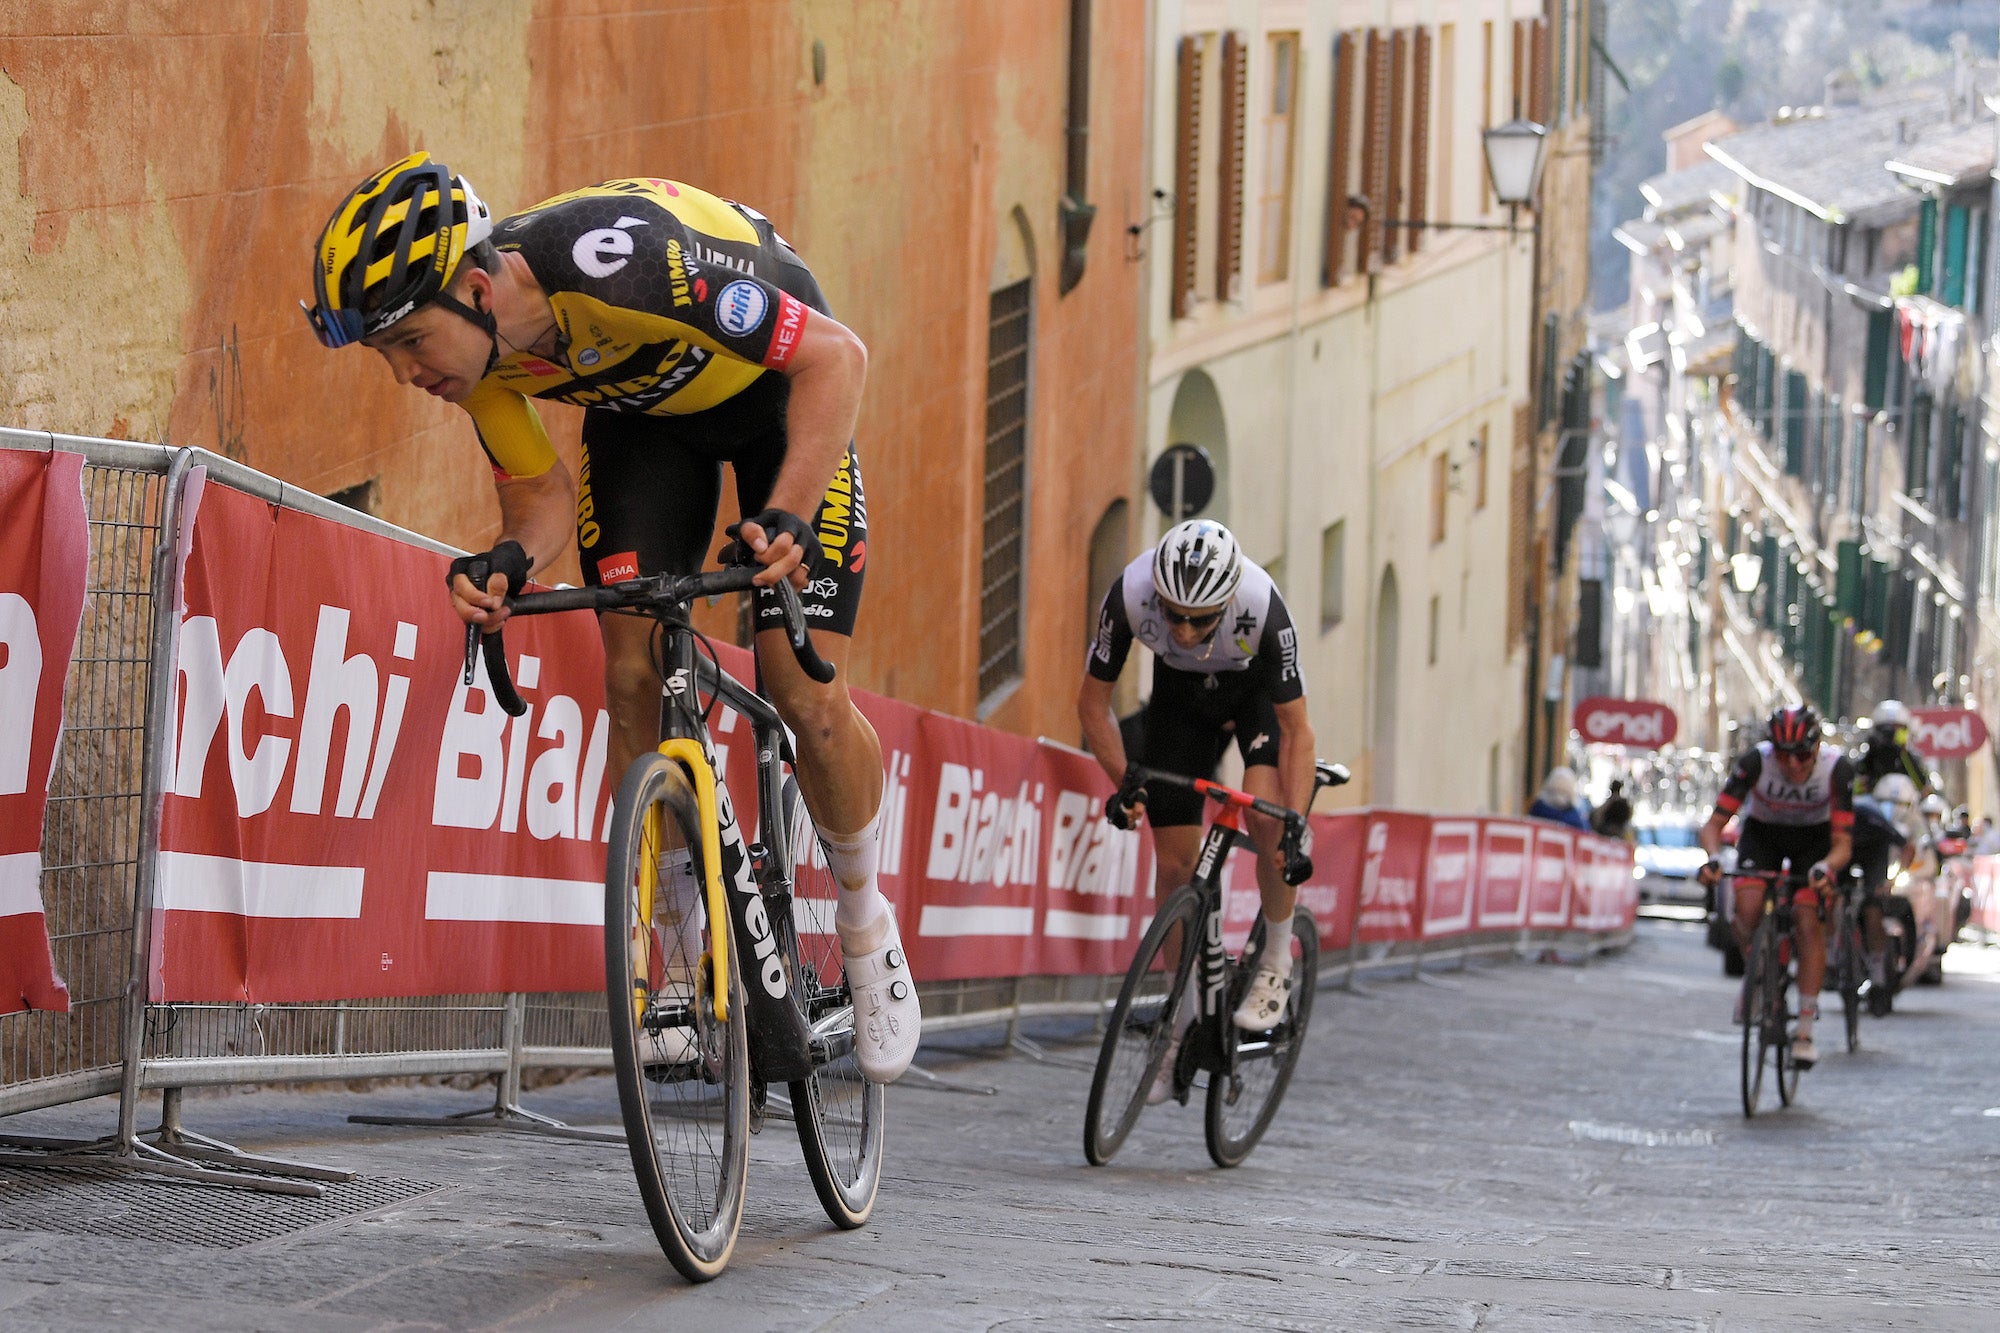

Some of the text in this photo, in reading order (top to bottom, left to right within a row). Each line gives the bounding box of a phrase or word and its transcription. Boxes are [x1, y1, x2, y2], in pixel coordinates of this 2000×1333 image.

[326, 247, 337, 275] WOUT
[434, 226, 450, 272] JUMBO
[666, 239, 692, 307] JUMBO
[772, 297, 803, 361] HEMA
[602, 564, 635, 582] HEMA
[761, 604, 834, 618] ceélo
[1277, 626, 1297, 682] BMC
[1587, 711, 1663, 742] enel
[1911, 715, 1972, 750] nel
[1767, 781, 1820, 801] UAE
[1196, 829, 1224, 881] BMC
